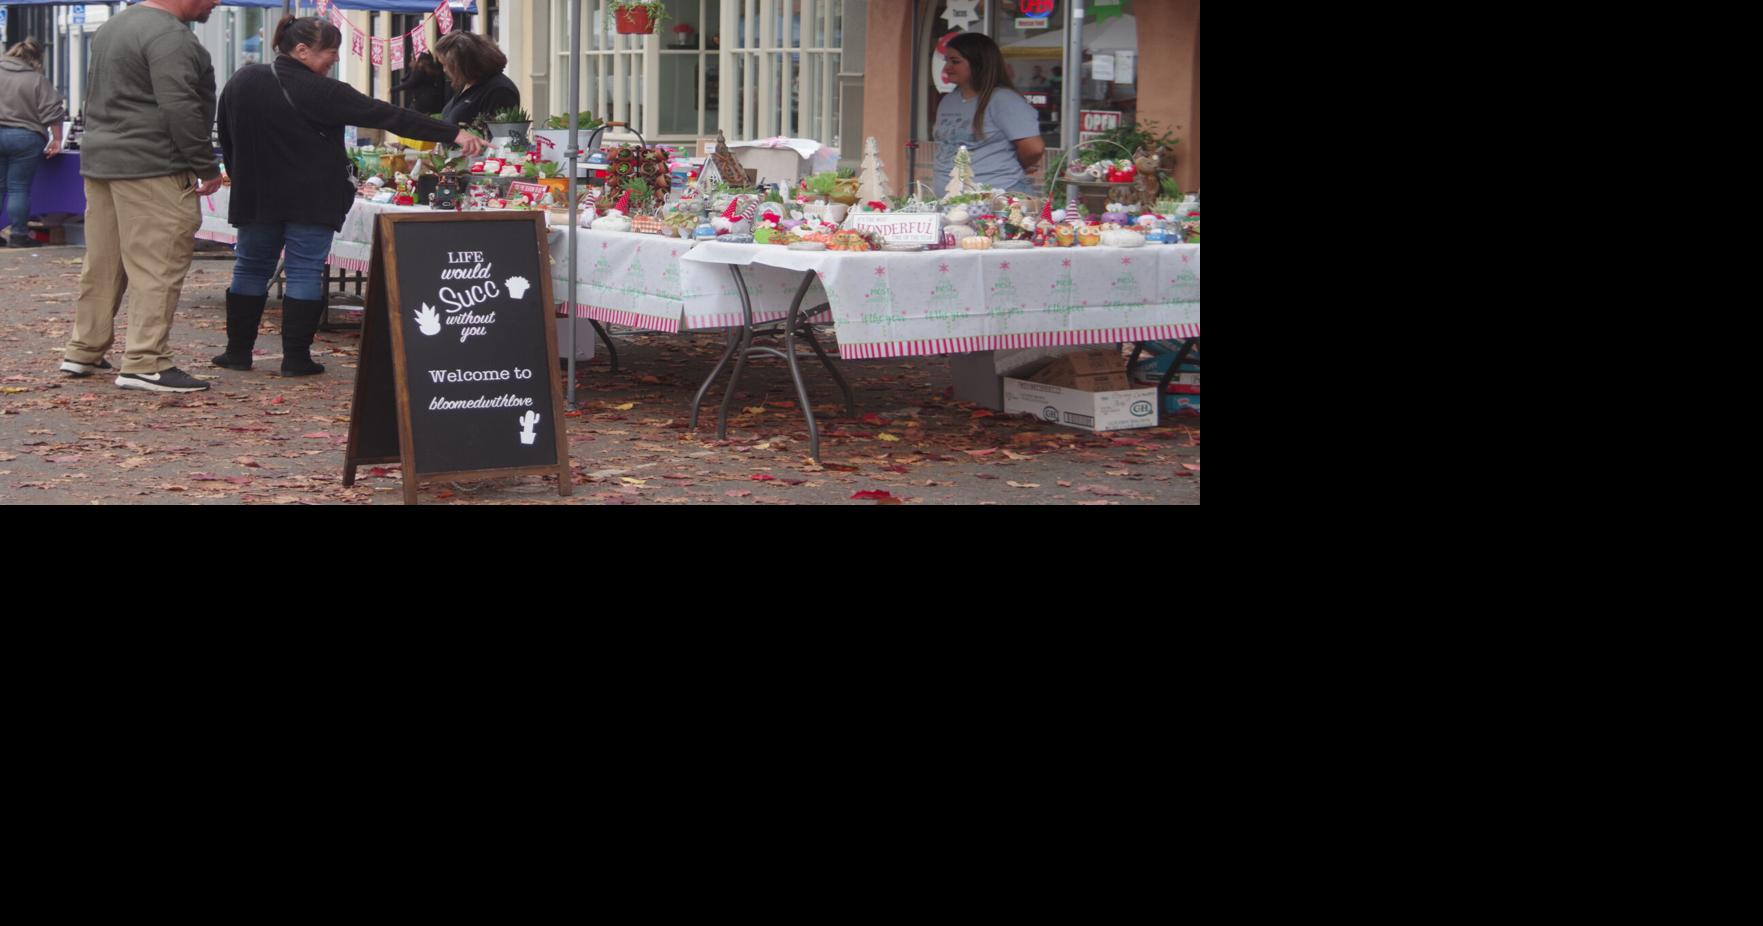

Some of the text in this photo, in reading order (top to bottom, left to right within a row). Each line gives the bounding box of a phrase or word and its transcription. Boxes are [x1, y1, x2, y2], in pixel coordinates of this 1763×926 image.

[1084, 113, 1117, 131] OPEN
[448, 251, 484, 264] LIFE
[441, 262, 491, 280] would
[439, 281, 499, 313] Succ
[446, 311, 495, 325] without
[460, 326, 487, 343] you
[428, 367, 532, 383] Welcome to
[428, 394, 533, 410] bloomedwithlove
[1132, 404, 1149, 413] GH
